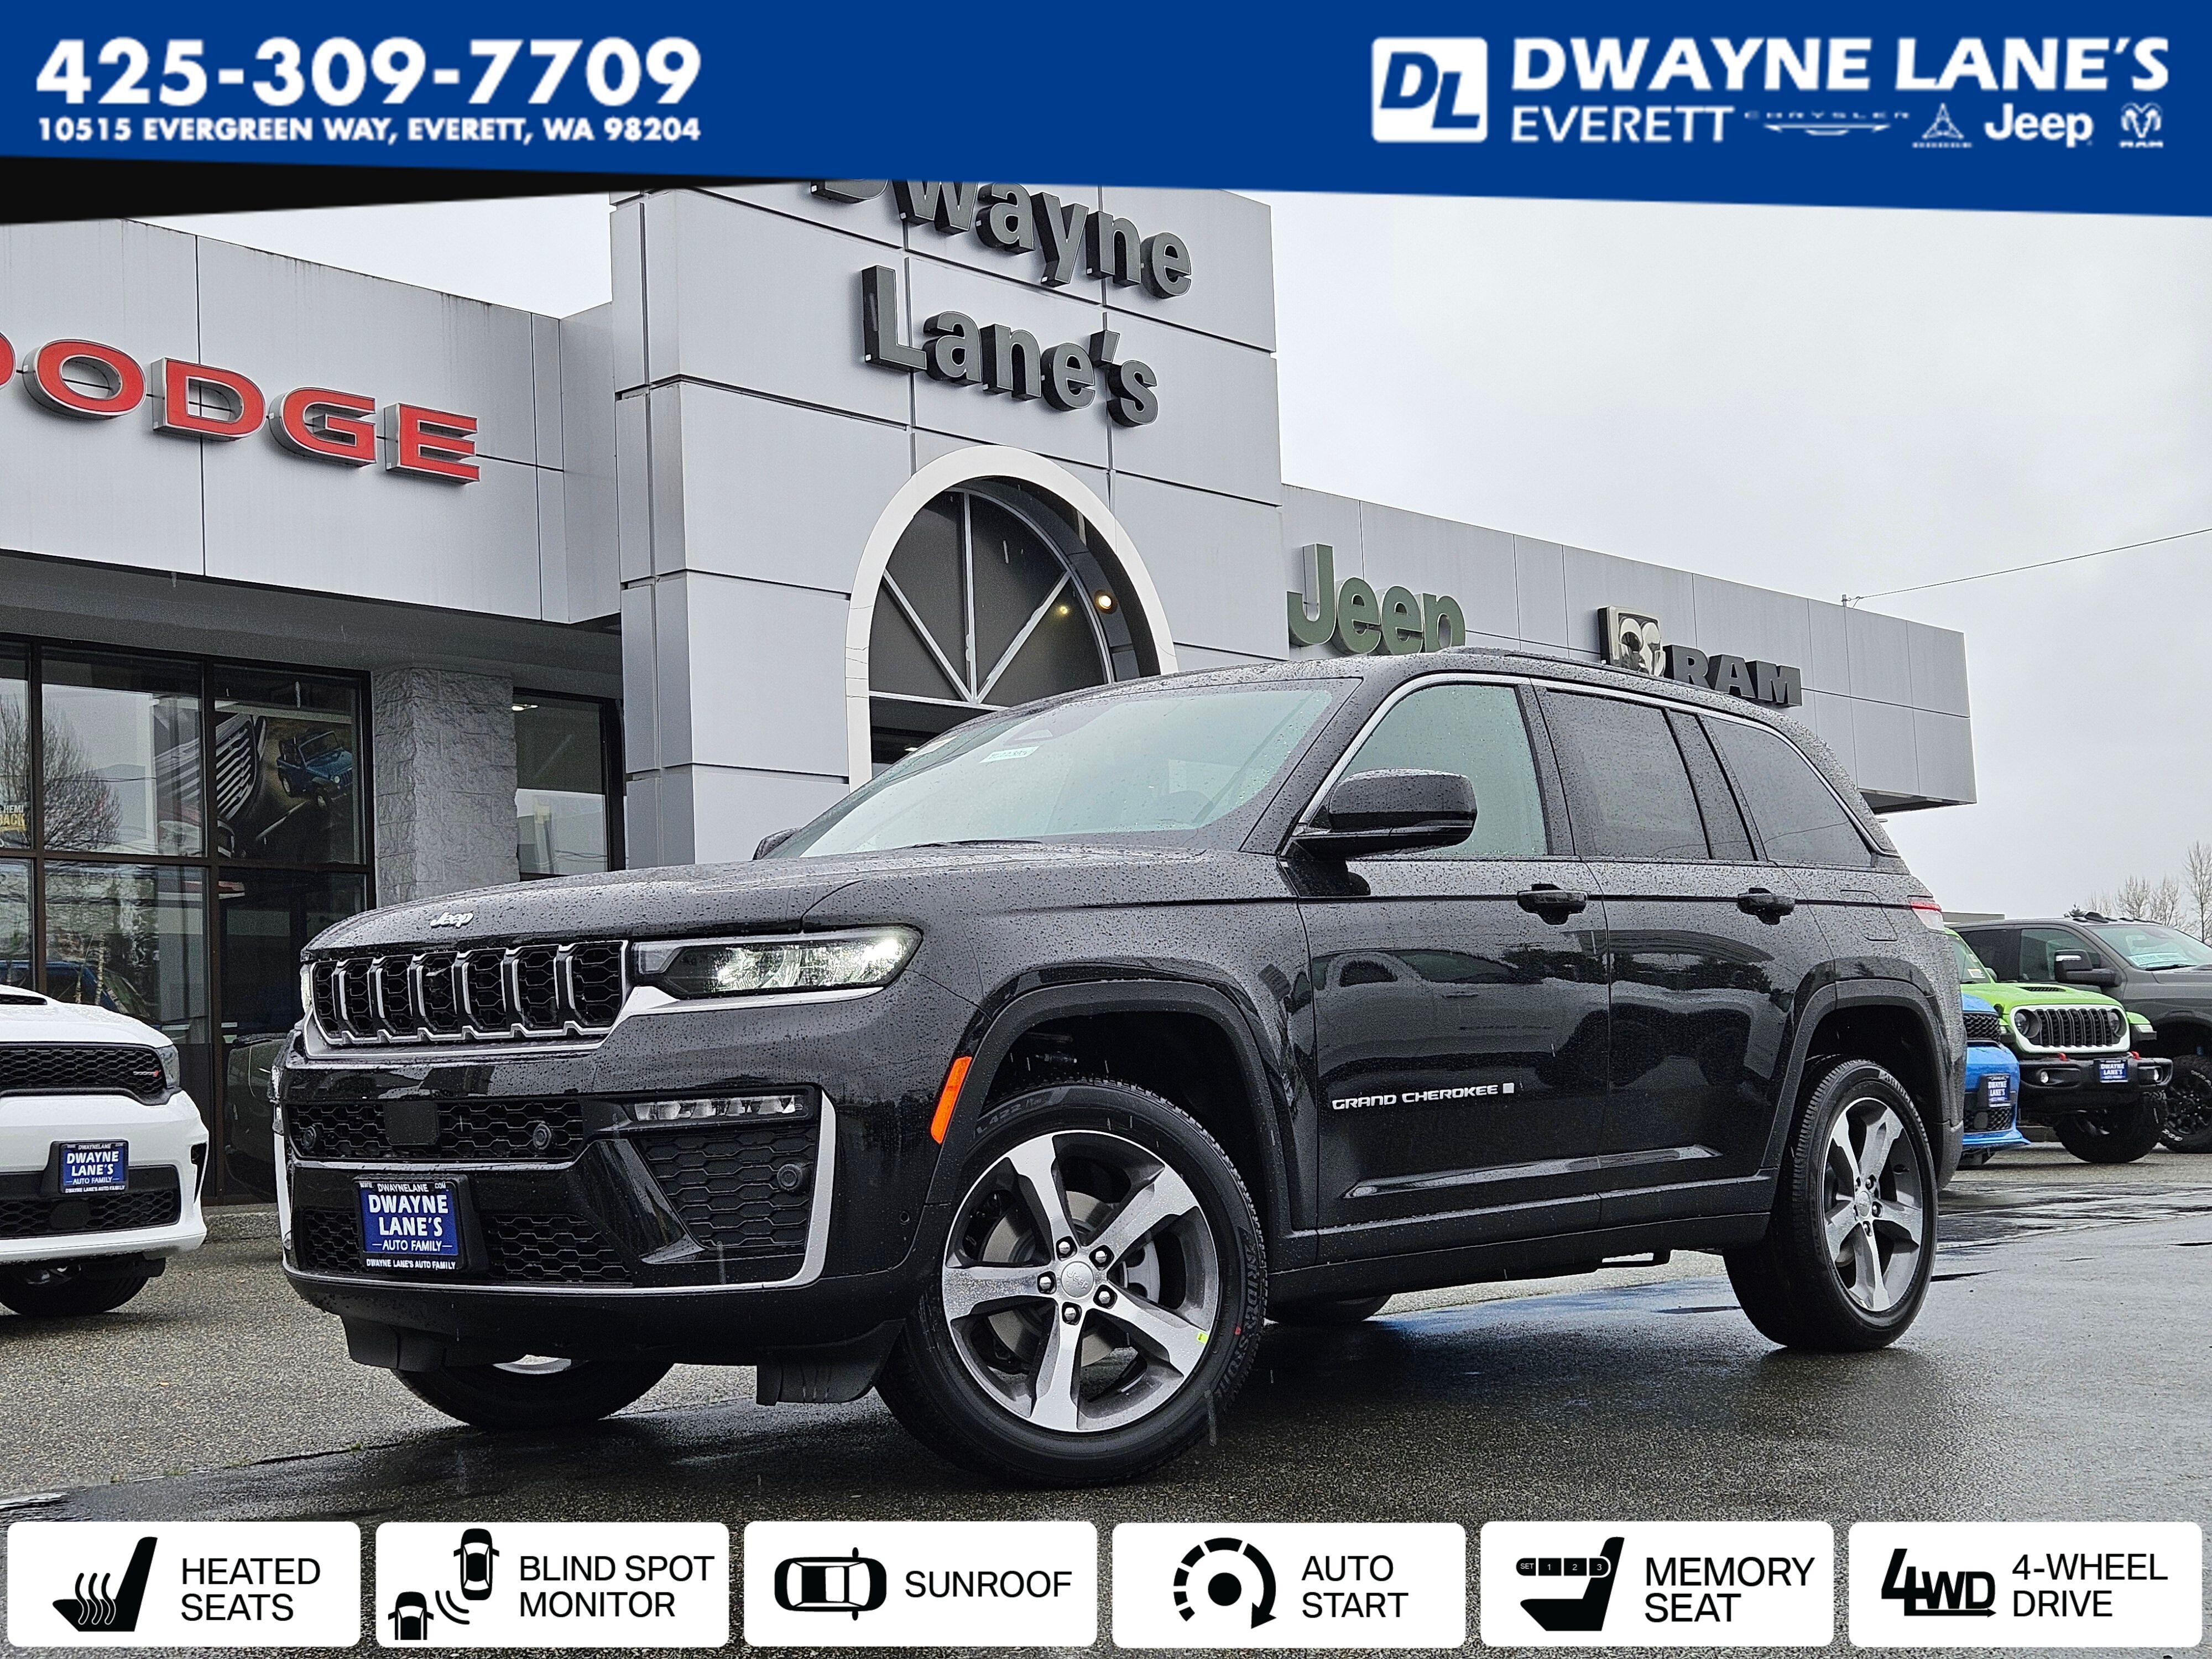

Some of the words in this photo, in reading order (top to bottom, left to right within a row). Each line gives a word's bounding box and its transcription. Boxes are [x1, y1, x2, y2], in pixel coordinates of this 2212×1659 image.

[811, 179, 1192, 299] wayne
[862, 265, 1158, 427] Lane's
[0, 336, 481, 484] ODGE
[1663, 644, 1802, 707] RAM
[430, 911, 474, 928] Jeep
[1332, 1094, 1397, 1110] GRAND
[1402, 1084, 1499, 1103] CHEROKEE
[66, 1151, 119, 1164] DWAYNE
[71, 1164, 114, 1177] LANE'S
[377, 1183, 429, 1192] DWAYNELANE
[368, 1194, 448, 1214] DWAYNE
[378, 1217, 443, 1237] LANE'S
[382, 1240, 408, 1251] AUTO
[411, 1240, 442, 1252] FAMILY
[366, 1259, 392, 1267] DWAYNE
[414, 1260, 431, 1269] AUTO
[432, 1261, 456, 1270] FAMILY
[1067, 1269, 1089, 1290] Jeep
